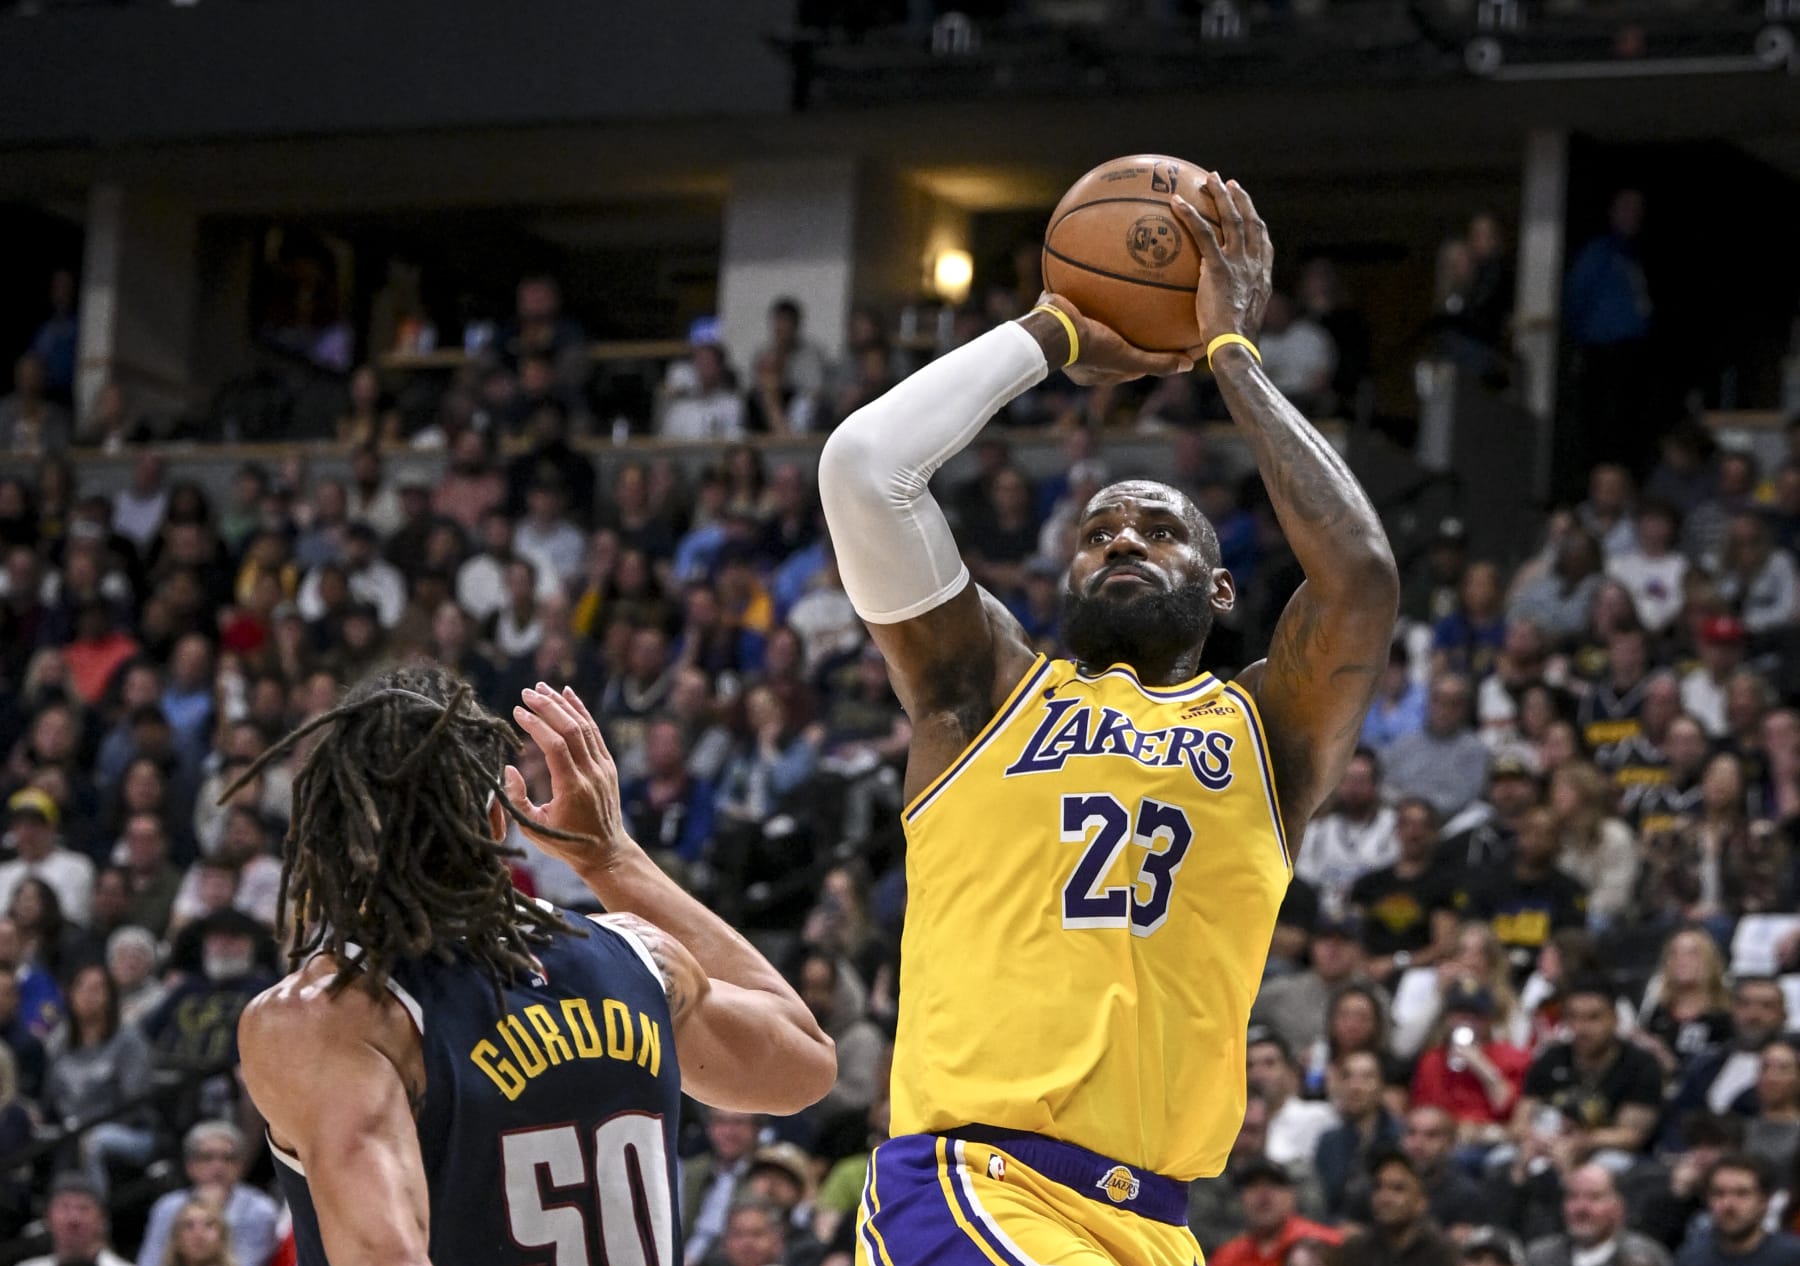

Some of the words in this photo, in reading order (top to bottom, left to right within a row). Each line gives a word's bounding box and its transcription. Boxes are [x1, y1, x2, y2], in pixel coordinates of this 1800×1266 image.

[1003, 698, 1235, 790] LAKERS
[1180, 706, 1236, 720] bibigo
[1060, 792, 1195, 938] 23
[470, 998, 661, 1101] GORDON
